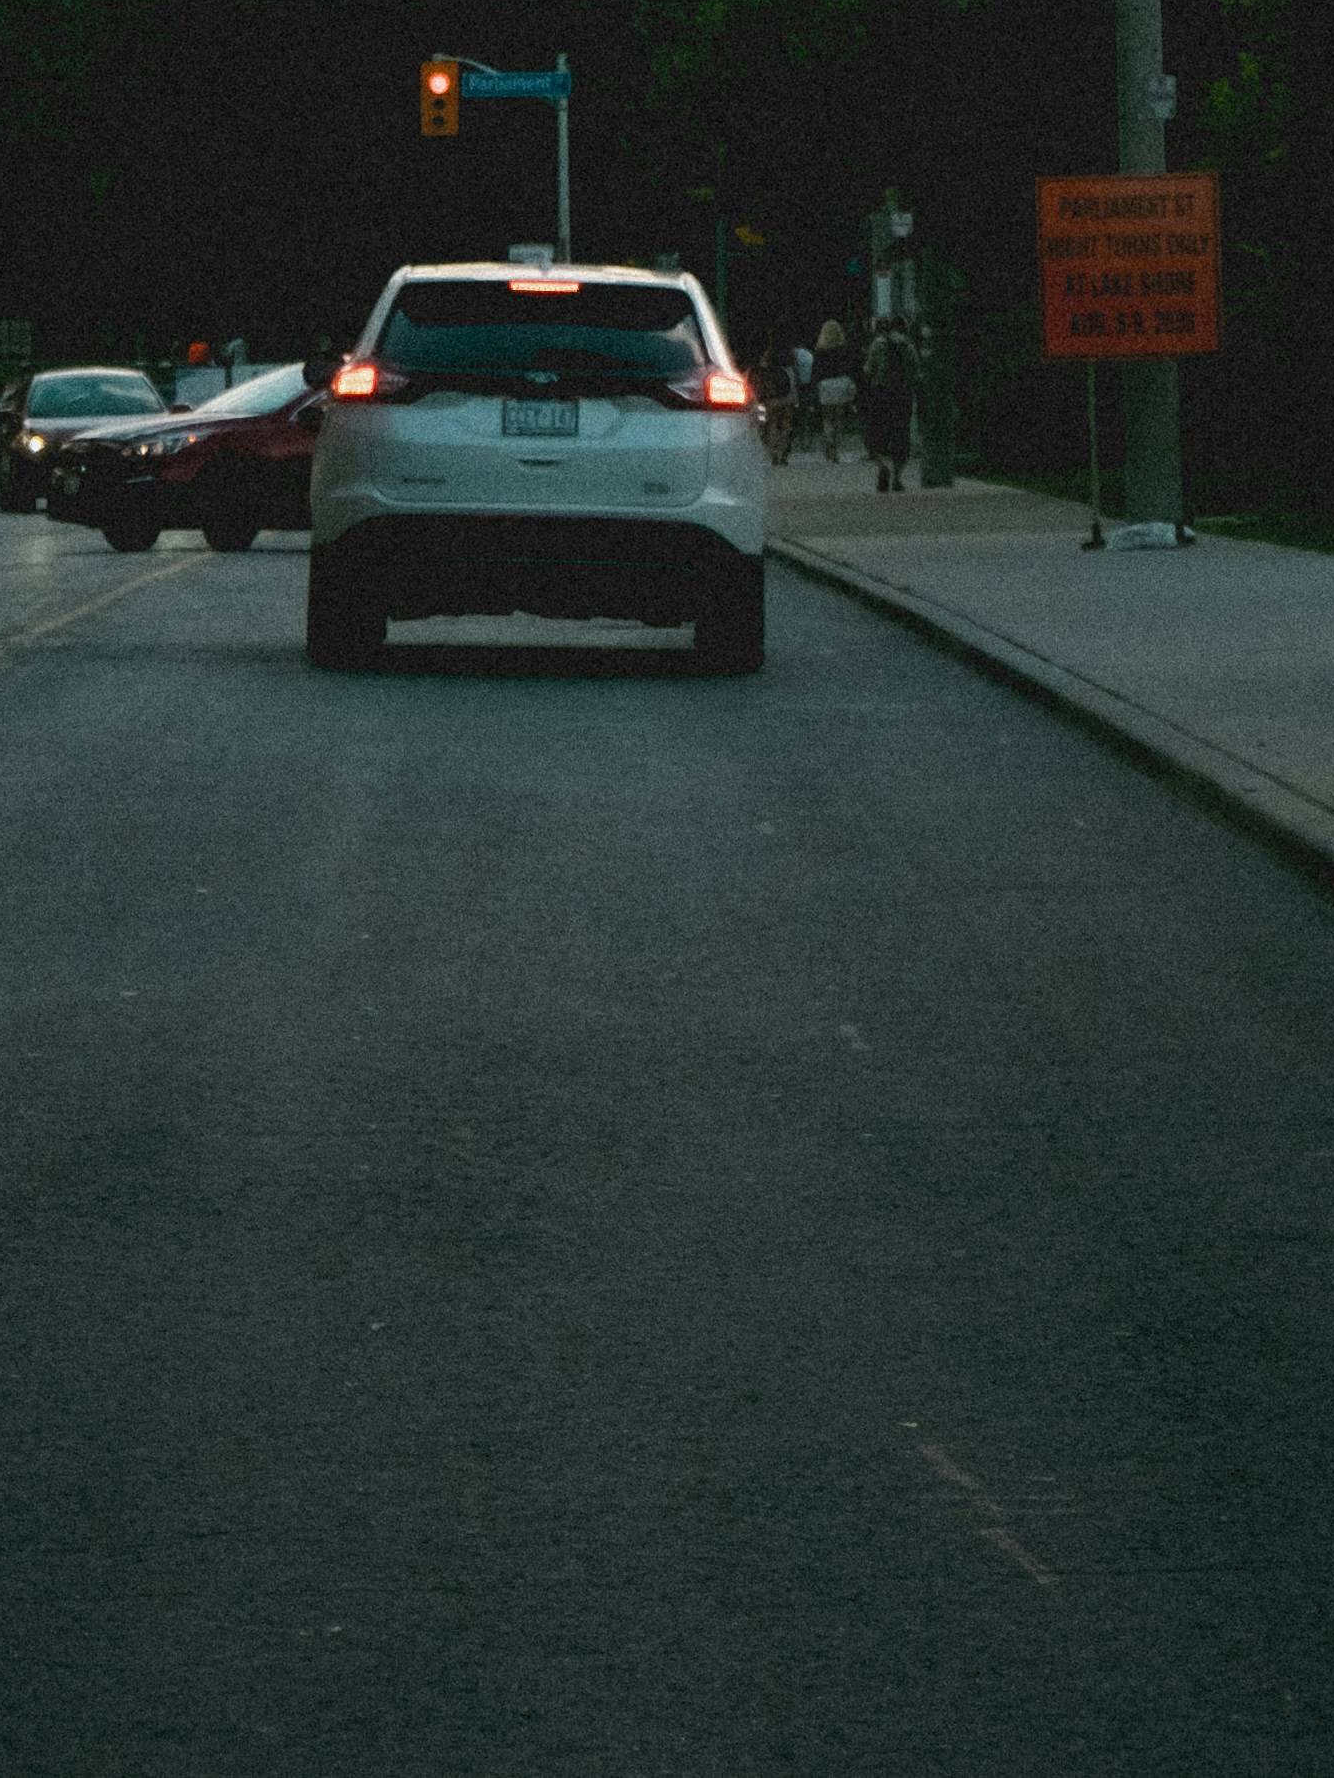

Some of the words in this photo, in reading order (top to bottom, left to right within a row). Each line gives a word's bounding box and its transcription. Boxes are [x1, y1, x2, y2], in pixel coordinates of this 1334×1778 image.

[1059, 194, 1166, 220] PARLIAMENT
[1105, 234, 1161, 258] TURNS
[1167, 232, 1210, 257] ONLY
[1091, 271, 1133, 298] LAKE
[1140, 270, 1196, 296] SHORE
